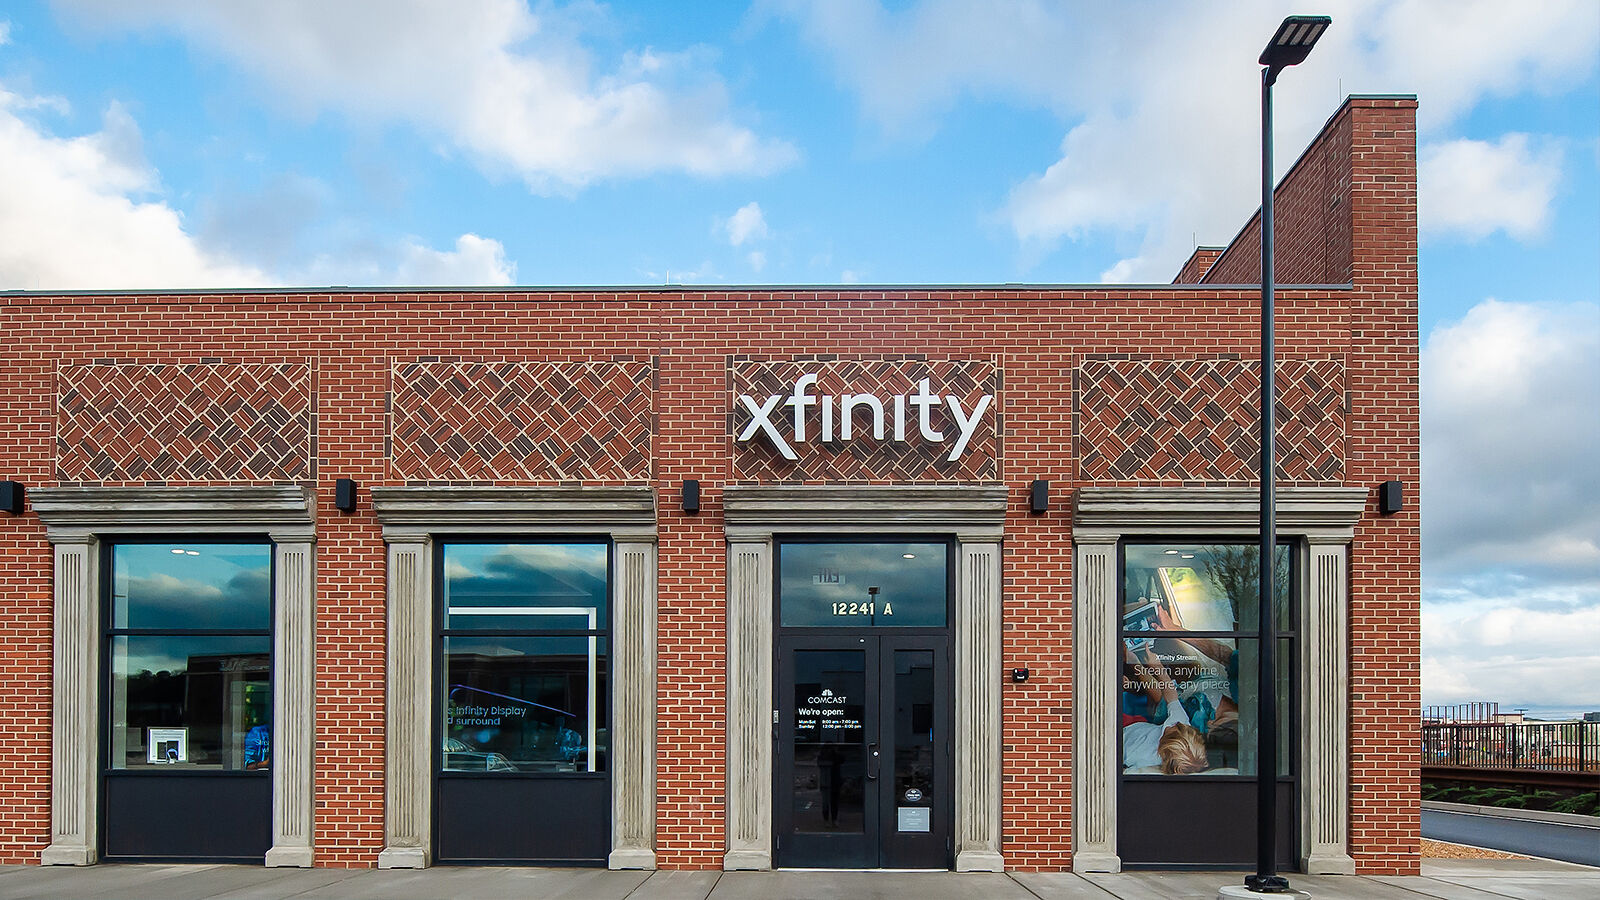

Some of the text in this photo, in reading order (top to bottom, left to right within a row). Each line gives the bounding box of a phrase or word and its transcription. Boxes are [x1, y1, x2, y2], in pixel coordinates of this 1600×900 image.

[738, 373, 993, 462] xfinity
[832, 602, 893, 615] 12241 A
[1134, 664, 1172, 676] Stream
[1123, 679, 1230, 691] anywhere, any place
[491, 706, 527, 718] Display
[456, 717, 500, 725] surround
